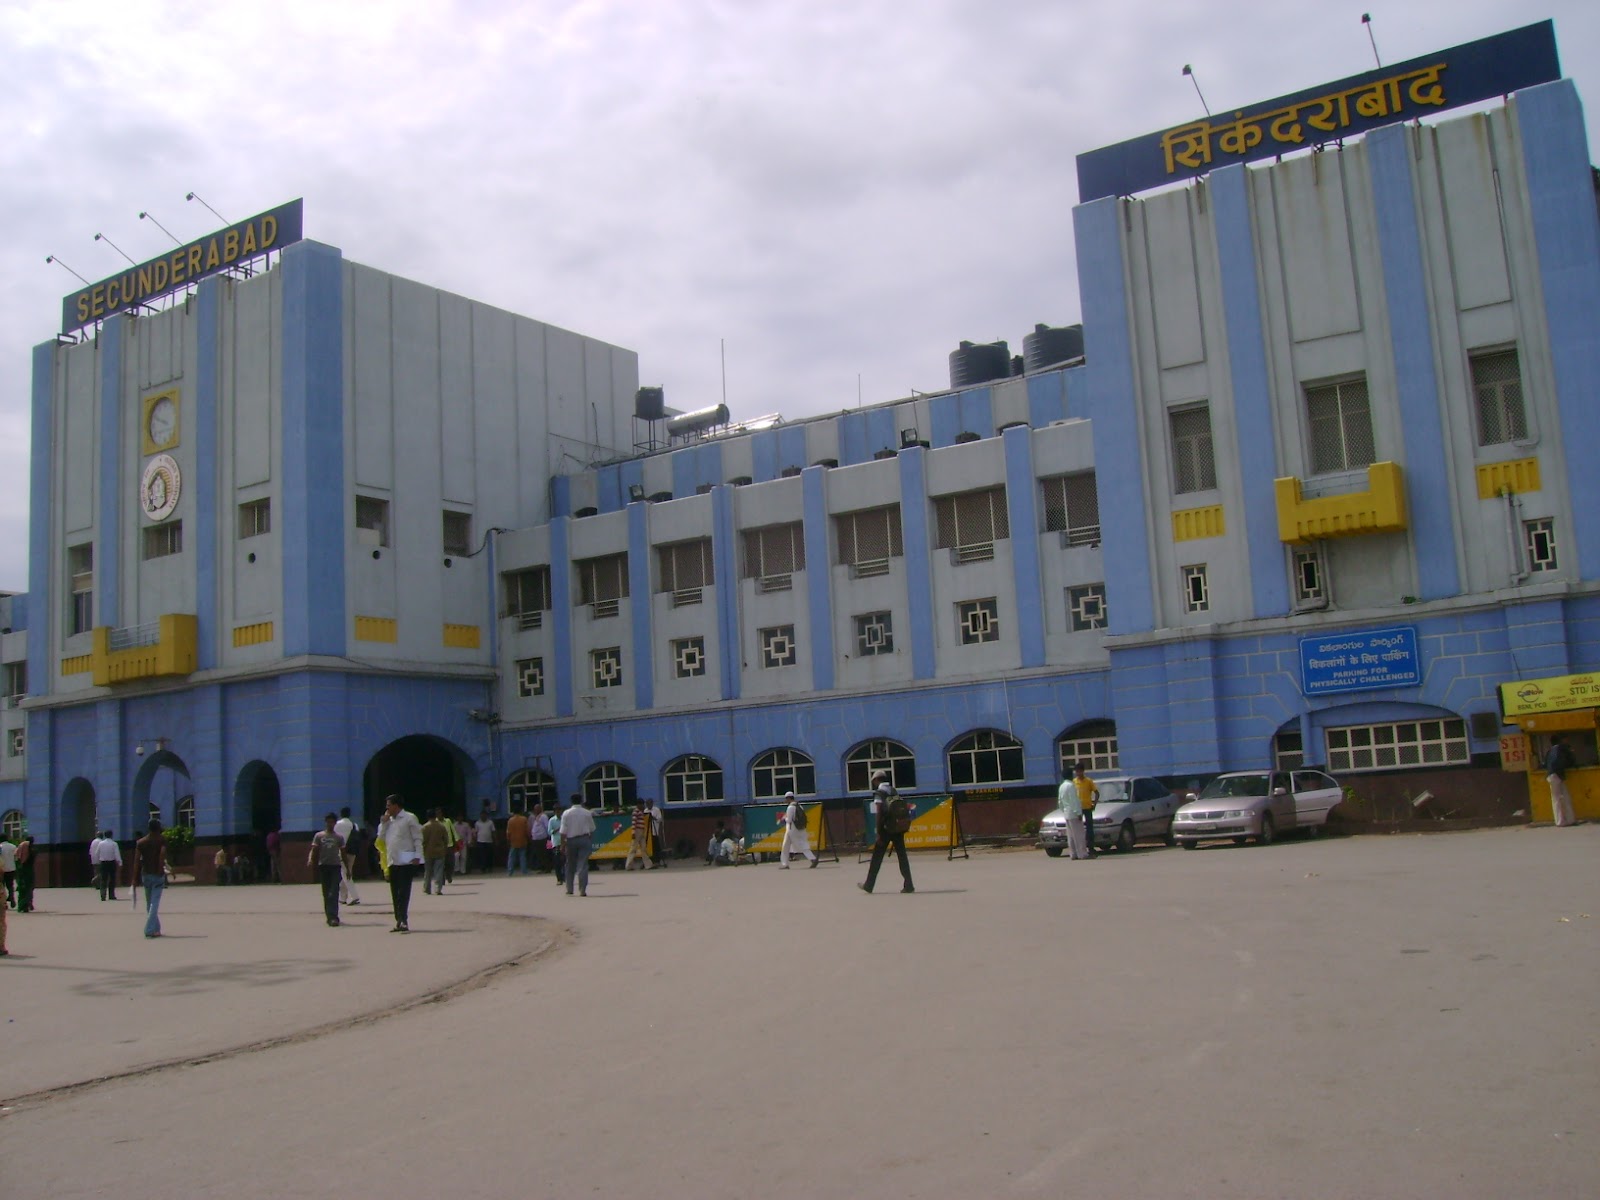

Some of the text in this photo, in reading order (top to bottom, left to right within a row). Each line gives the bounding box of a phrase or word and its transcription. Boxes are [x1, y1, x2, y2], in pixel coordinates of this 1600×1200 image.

[1160, 62, 1448, 175] सिकंदराबाद
[76, 214, 279, 323] SECUNDERABAD
[1350, 654, 1359, 665] के
[1361, 653, 1379, 665] लिए
[1310, 672, 1415, 689] PHYSICALLY CHALLENGED
[1333, 667, 1388, 679] PARKING FOR
